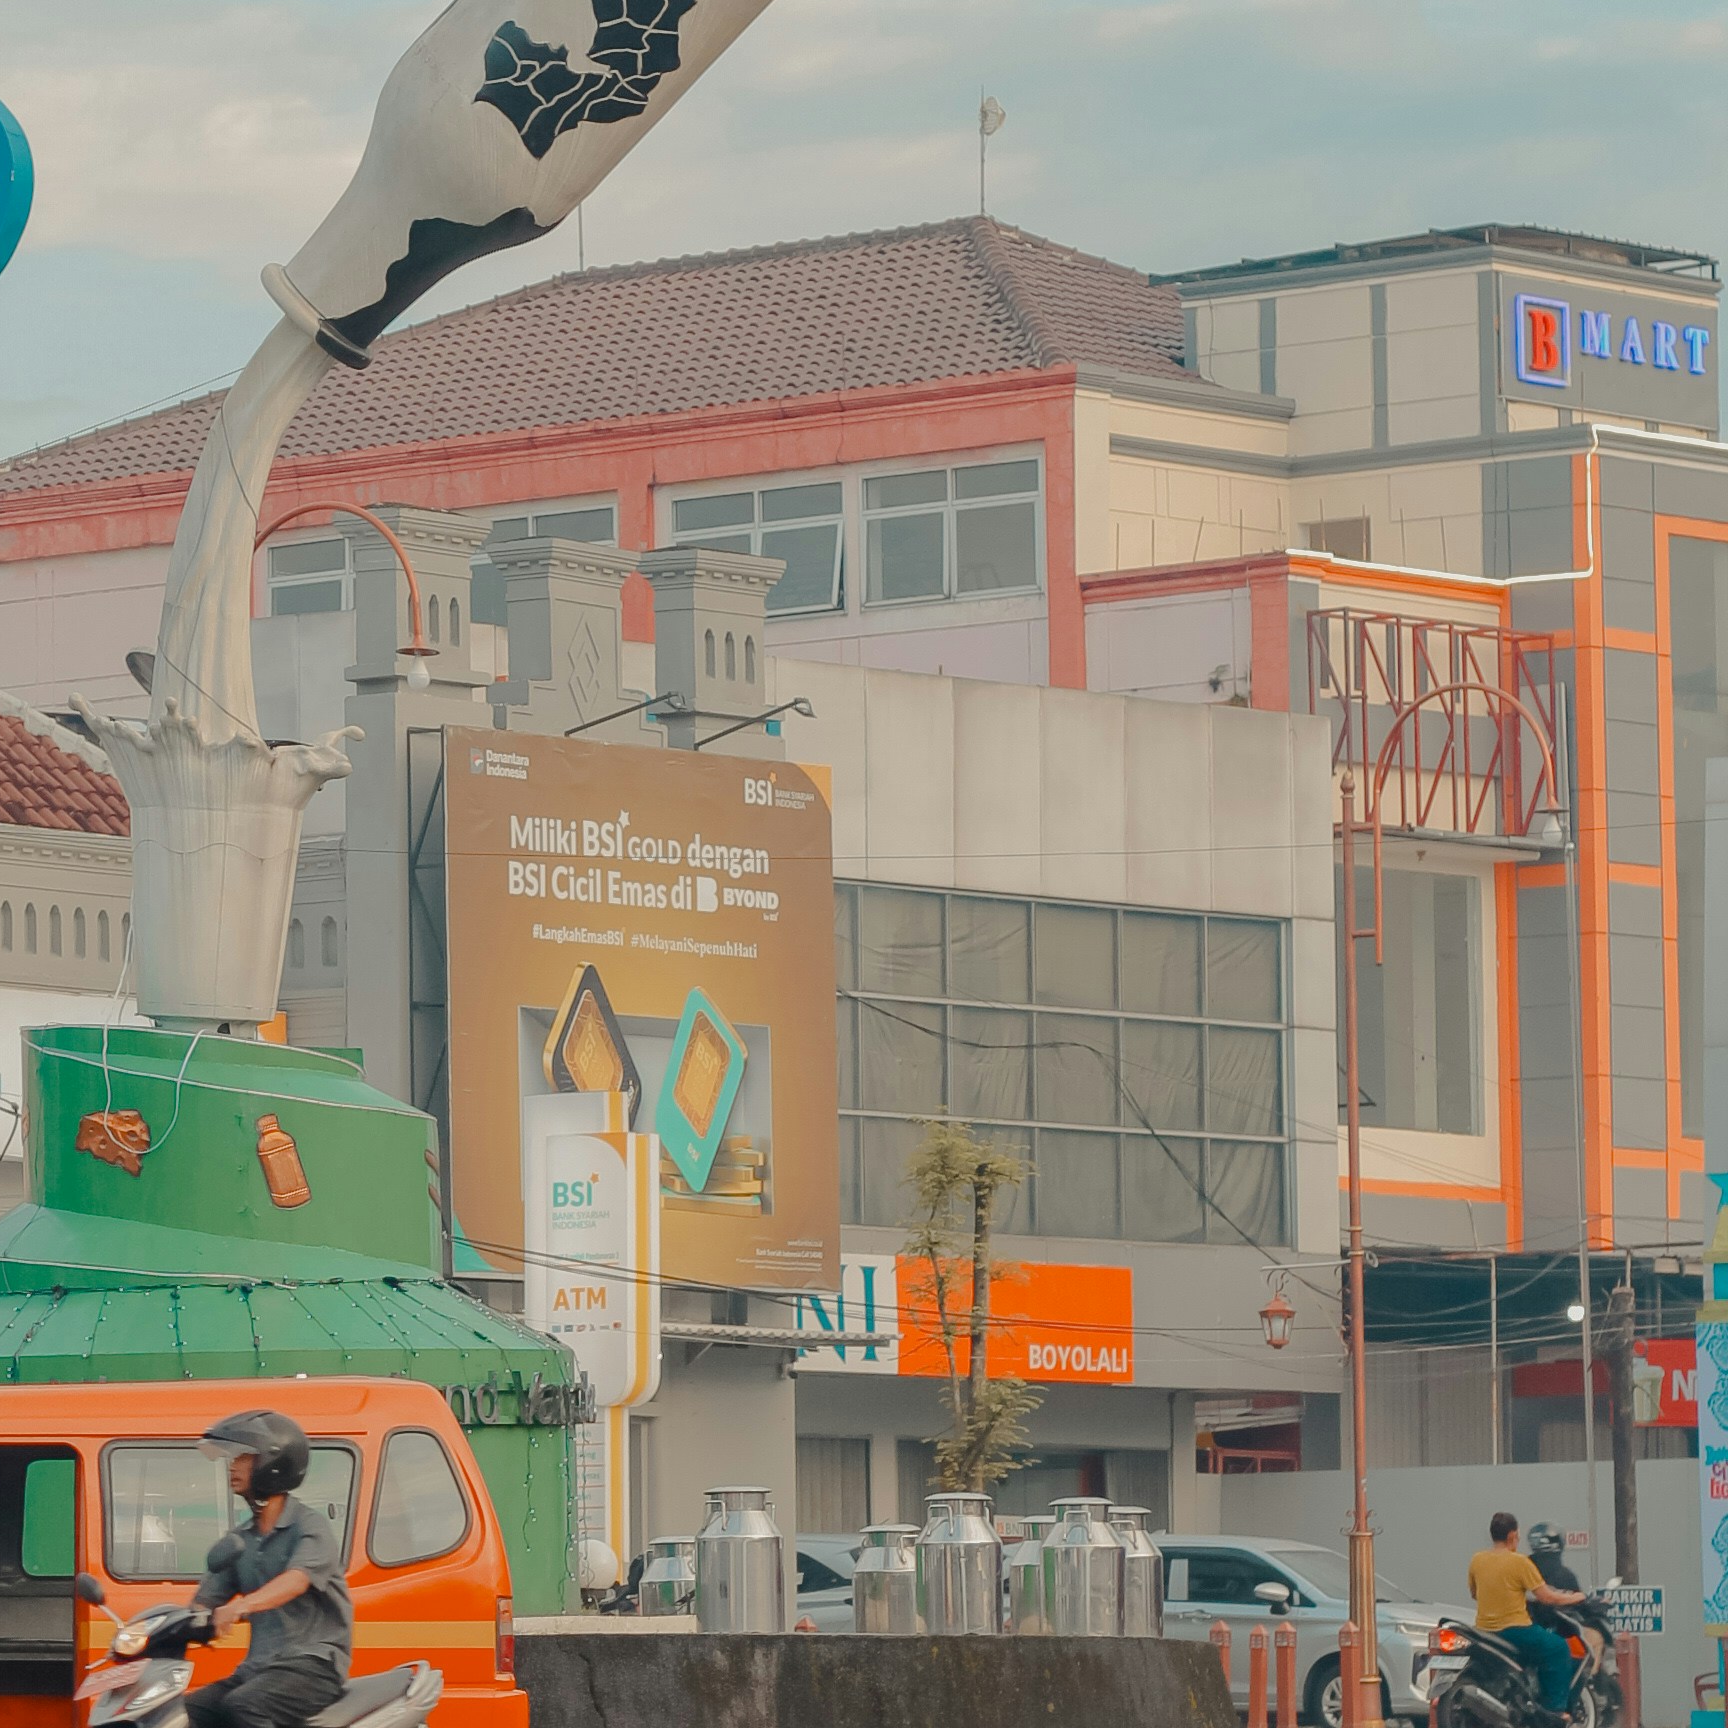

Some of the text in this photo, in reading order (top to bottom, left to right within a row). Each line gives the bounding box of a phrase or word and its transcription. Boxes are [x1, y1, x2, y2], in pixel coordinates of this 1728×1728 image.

[1528, 308, 1711, 374] B MART
[486, 749, 530, 767] Danantara
[486, 763, 527, 780] Indonesia
[744, 777, 772, 807] BSI
[511, 815, 770, 879] Miliki BSI GOLD dengan
[508, 860, 546, 898] BSI
[551, 865, 602, 903] Cicil
[608, 870, 667, 909] Emas
[671, 875, 692, 911] di
[723, 887, 780, 911] BYOND
[532, 923, 758, 959] #LangkahEmasBSI #MelayaniSepenuhHati
[552, 1180, 593, 1208] BSI
[552, 1211, 576, 1221] BANK
[552, 1220, 597, 1230] INDONESIA
[553, 1286, 607, 1312] ATM
[797, 1263, 879, 1365] NI
[1028, 1343, 1128, 1373] BOYOLALI
[1603, 1589, 1654, 1604] PARKIR
